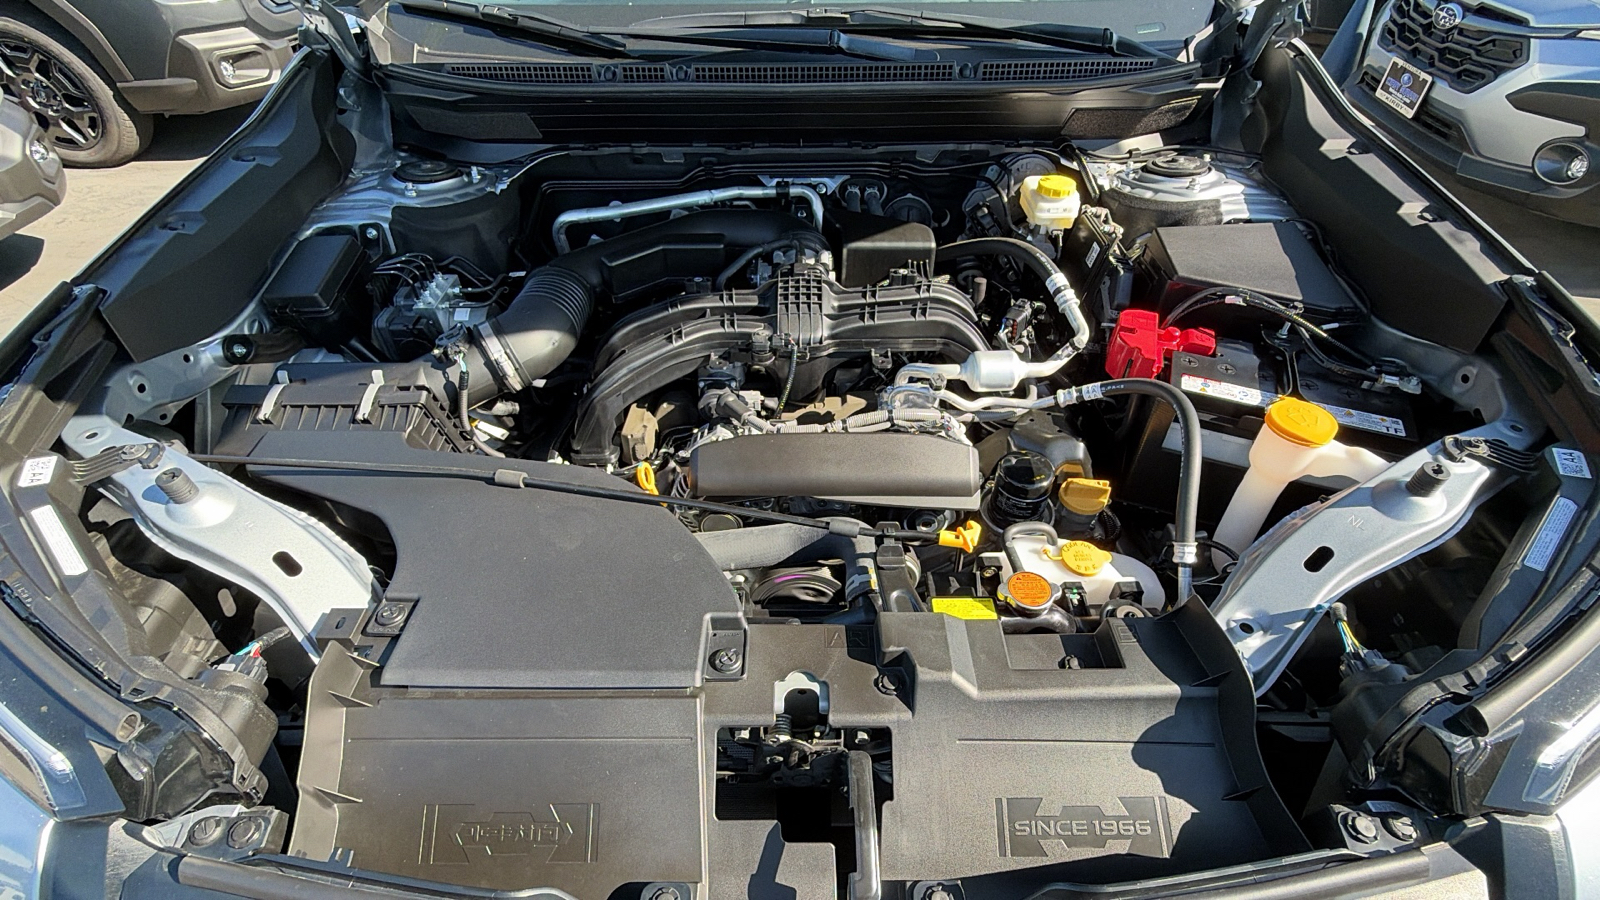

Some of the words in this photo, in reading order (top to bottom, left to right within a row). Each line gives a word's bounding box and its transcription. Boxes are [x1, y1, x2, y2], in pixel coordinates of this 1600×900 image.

[1385, 95, 1404, 110] KIRBY
[1014, 820, 1088, 836] SINCE
[1091, 820, 1152, 836] 1966
